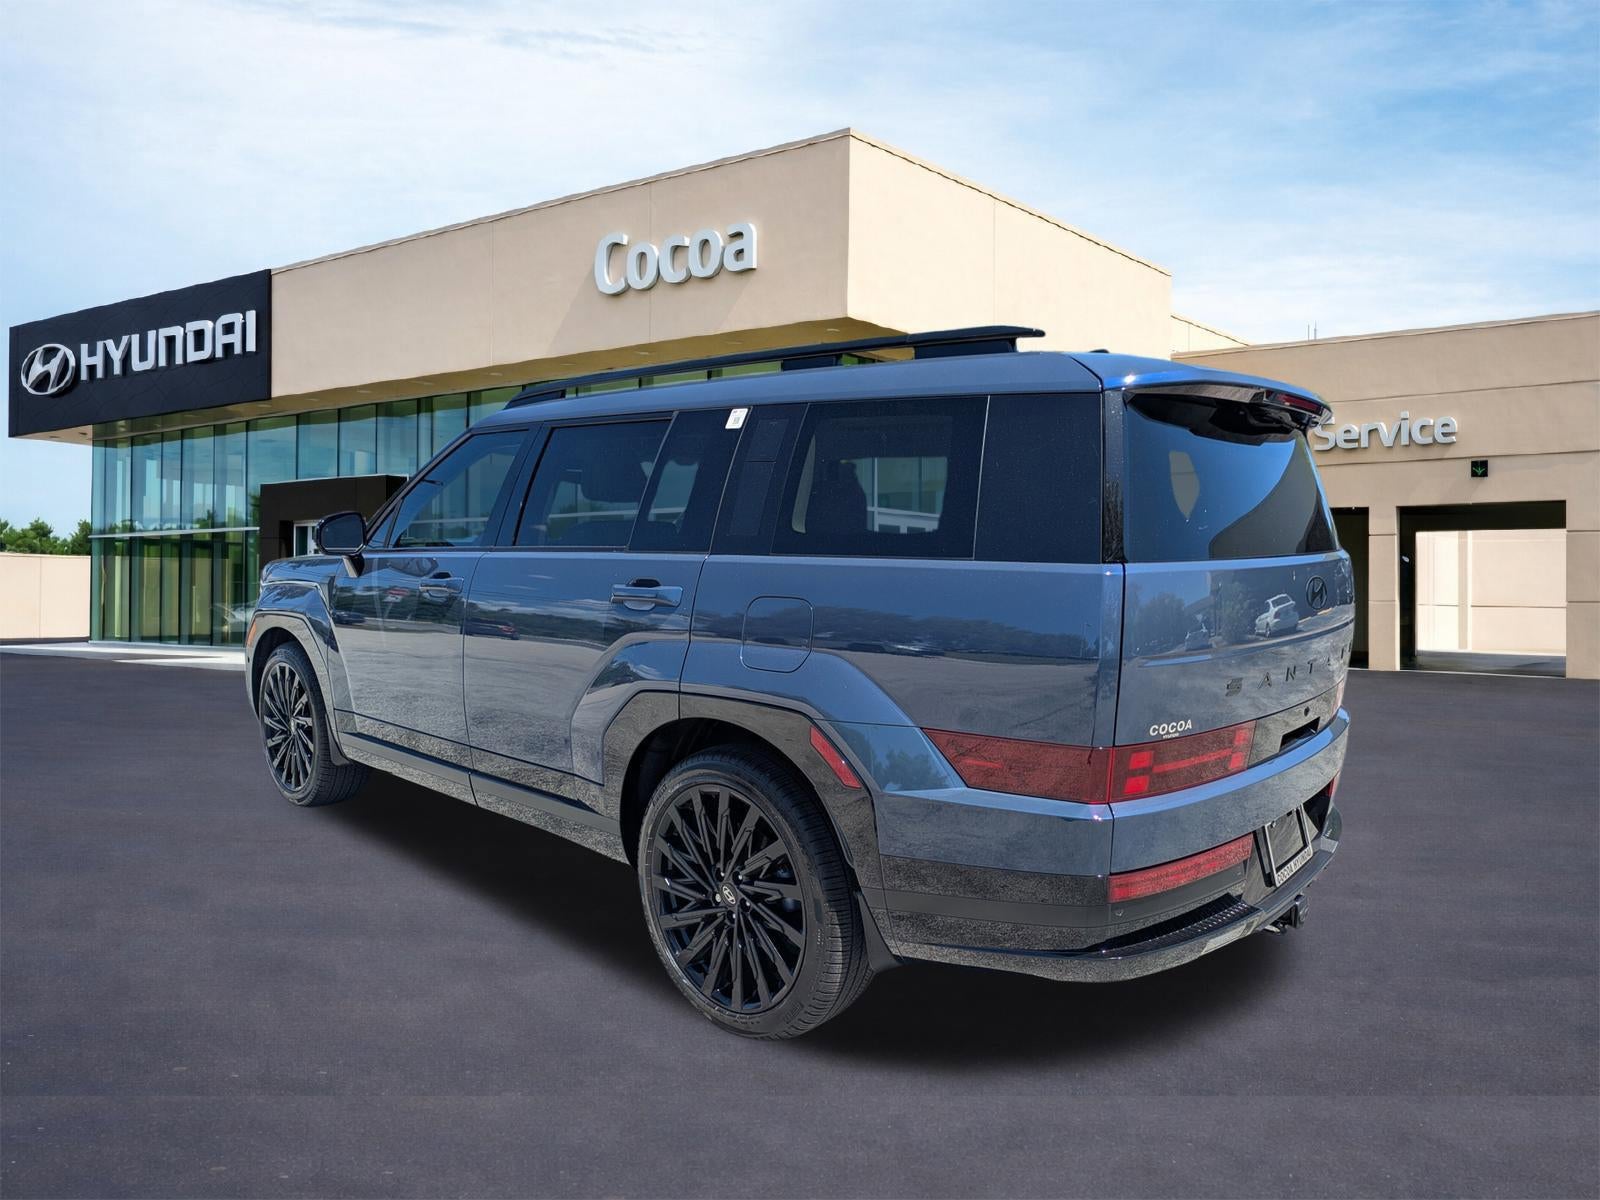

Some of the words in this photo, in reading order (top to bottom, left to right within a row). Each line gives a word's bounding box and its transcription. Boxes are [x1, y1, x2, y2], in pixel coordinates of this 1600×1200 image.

[594, 223, 757, 295] Cocoa
[80, 310, 256, 381] HYUNDAI
[1312, 411, 1458, 451] Service
[1149, 719, 1192, 736] COCOA
